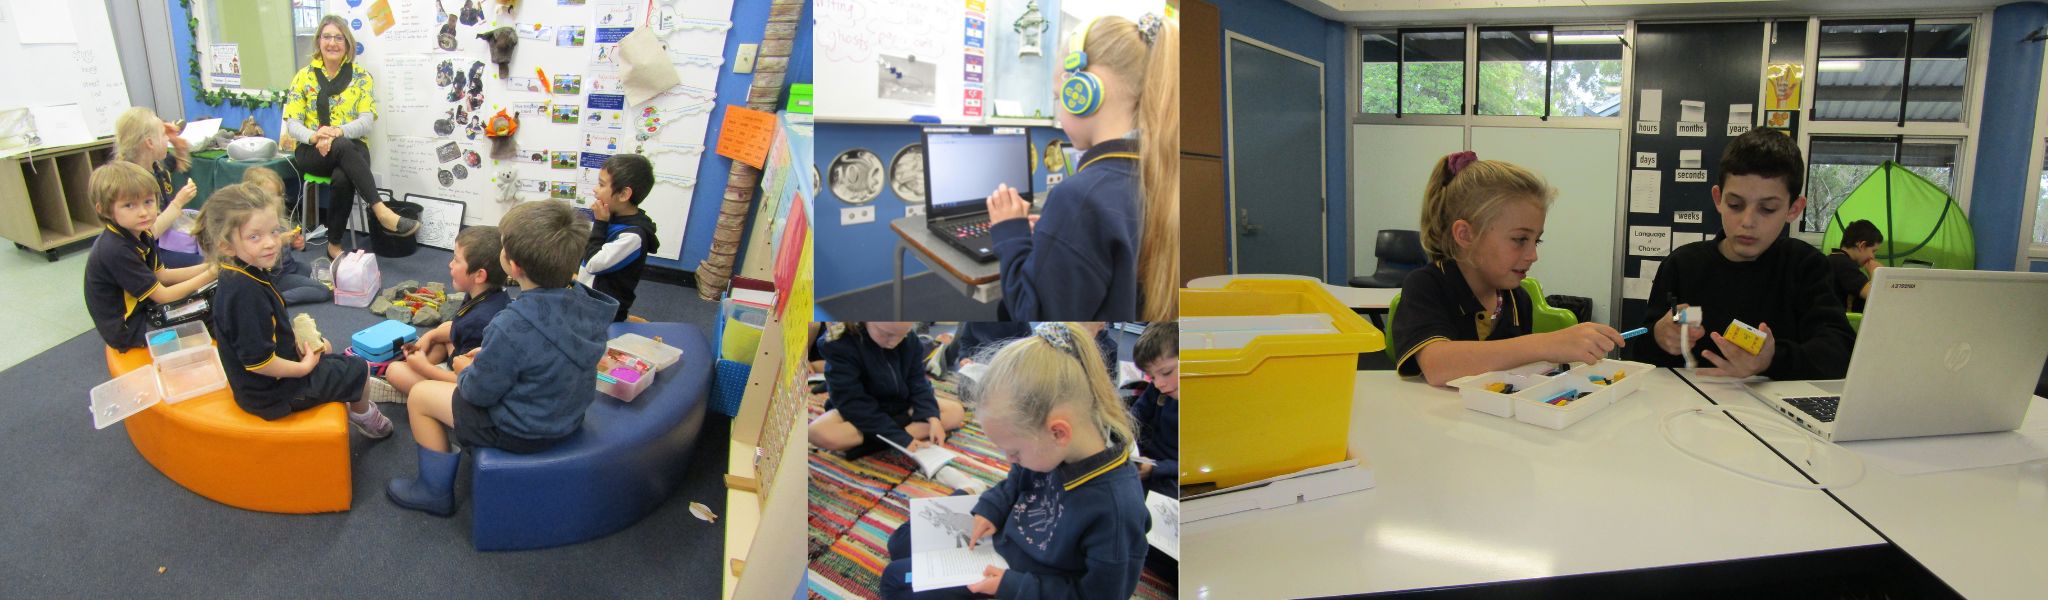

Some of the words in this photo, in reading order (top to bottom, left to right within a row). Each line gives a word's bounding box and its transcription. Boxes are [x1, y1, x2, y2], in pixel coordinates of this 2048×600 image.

[1639, 122, 1658, 131] hours
[1680, 123, 1704, 132] months
[1729, 125, 1749, 135] years
[1640, 154, 1656, 165] days
[1677, 170, 1705, 179] seconds
[1678, 212, 1700, 220] weeks
[1634, 230, 1666, 238] Language
